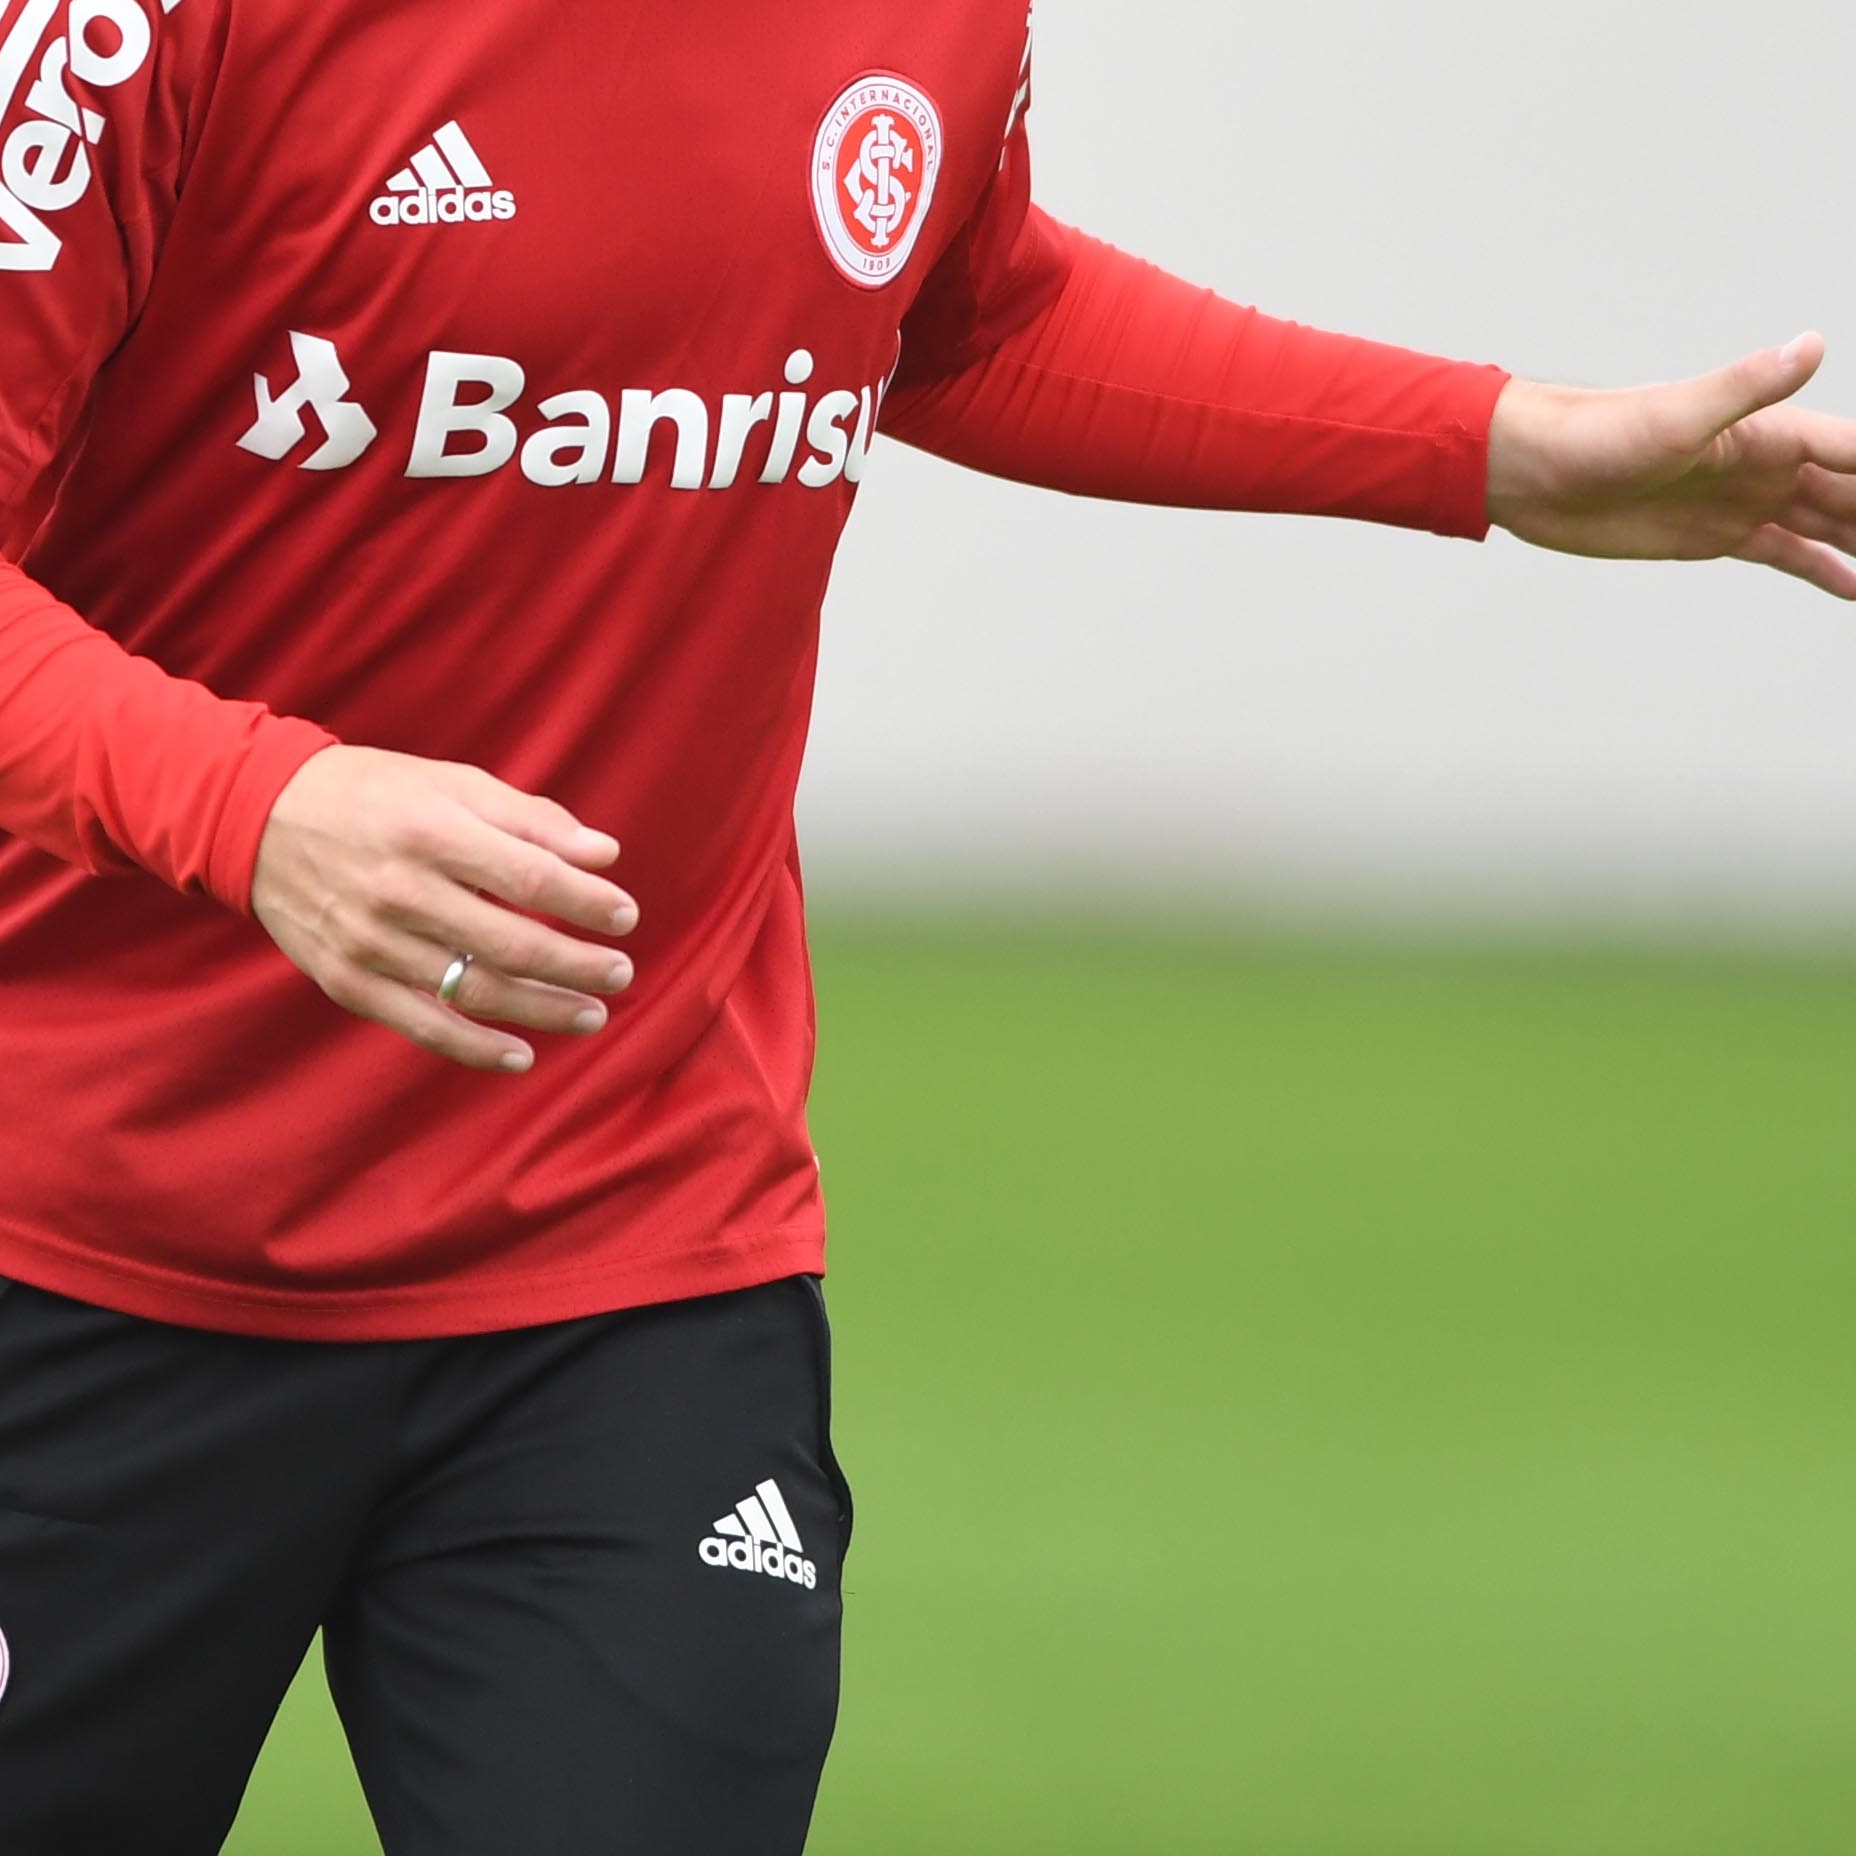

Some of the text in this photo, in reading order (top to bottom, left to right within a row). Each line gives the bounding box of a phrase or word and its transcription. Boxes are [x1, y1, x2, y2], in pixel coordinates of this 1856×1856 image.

[834, 88, 934, 171] INTERNACIONAL
[369, 185, 517, 226] adidas
[861, 256, 892, 272] 1909
[404, 328, 902, 490] Banrisu
[698, 1535, 817, 1590] adidas
